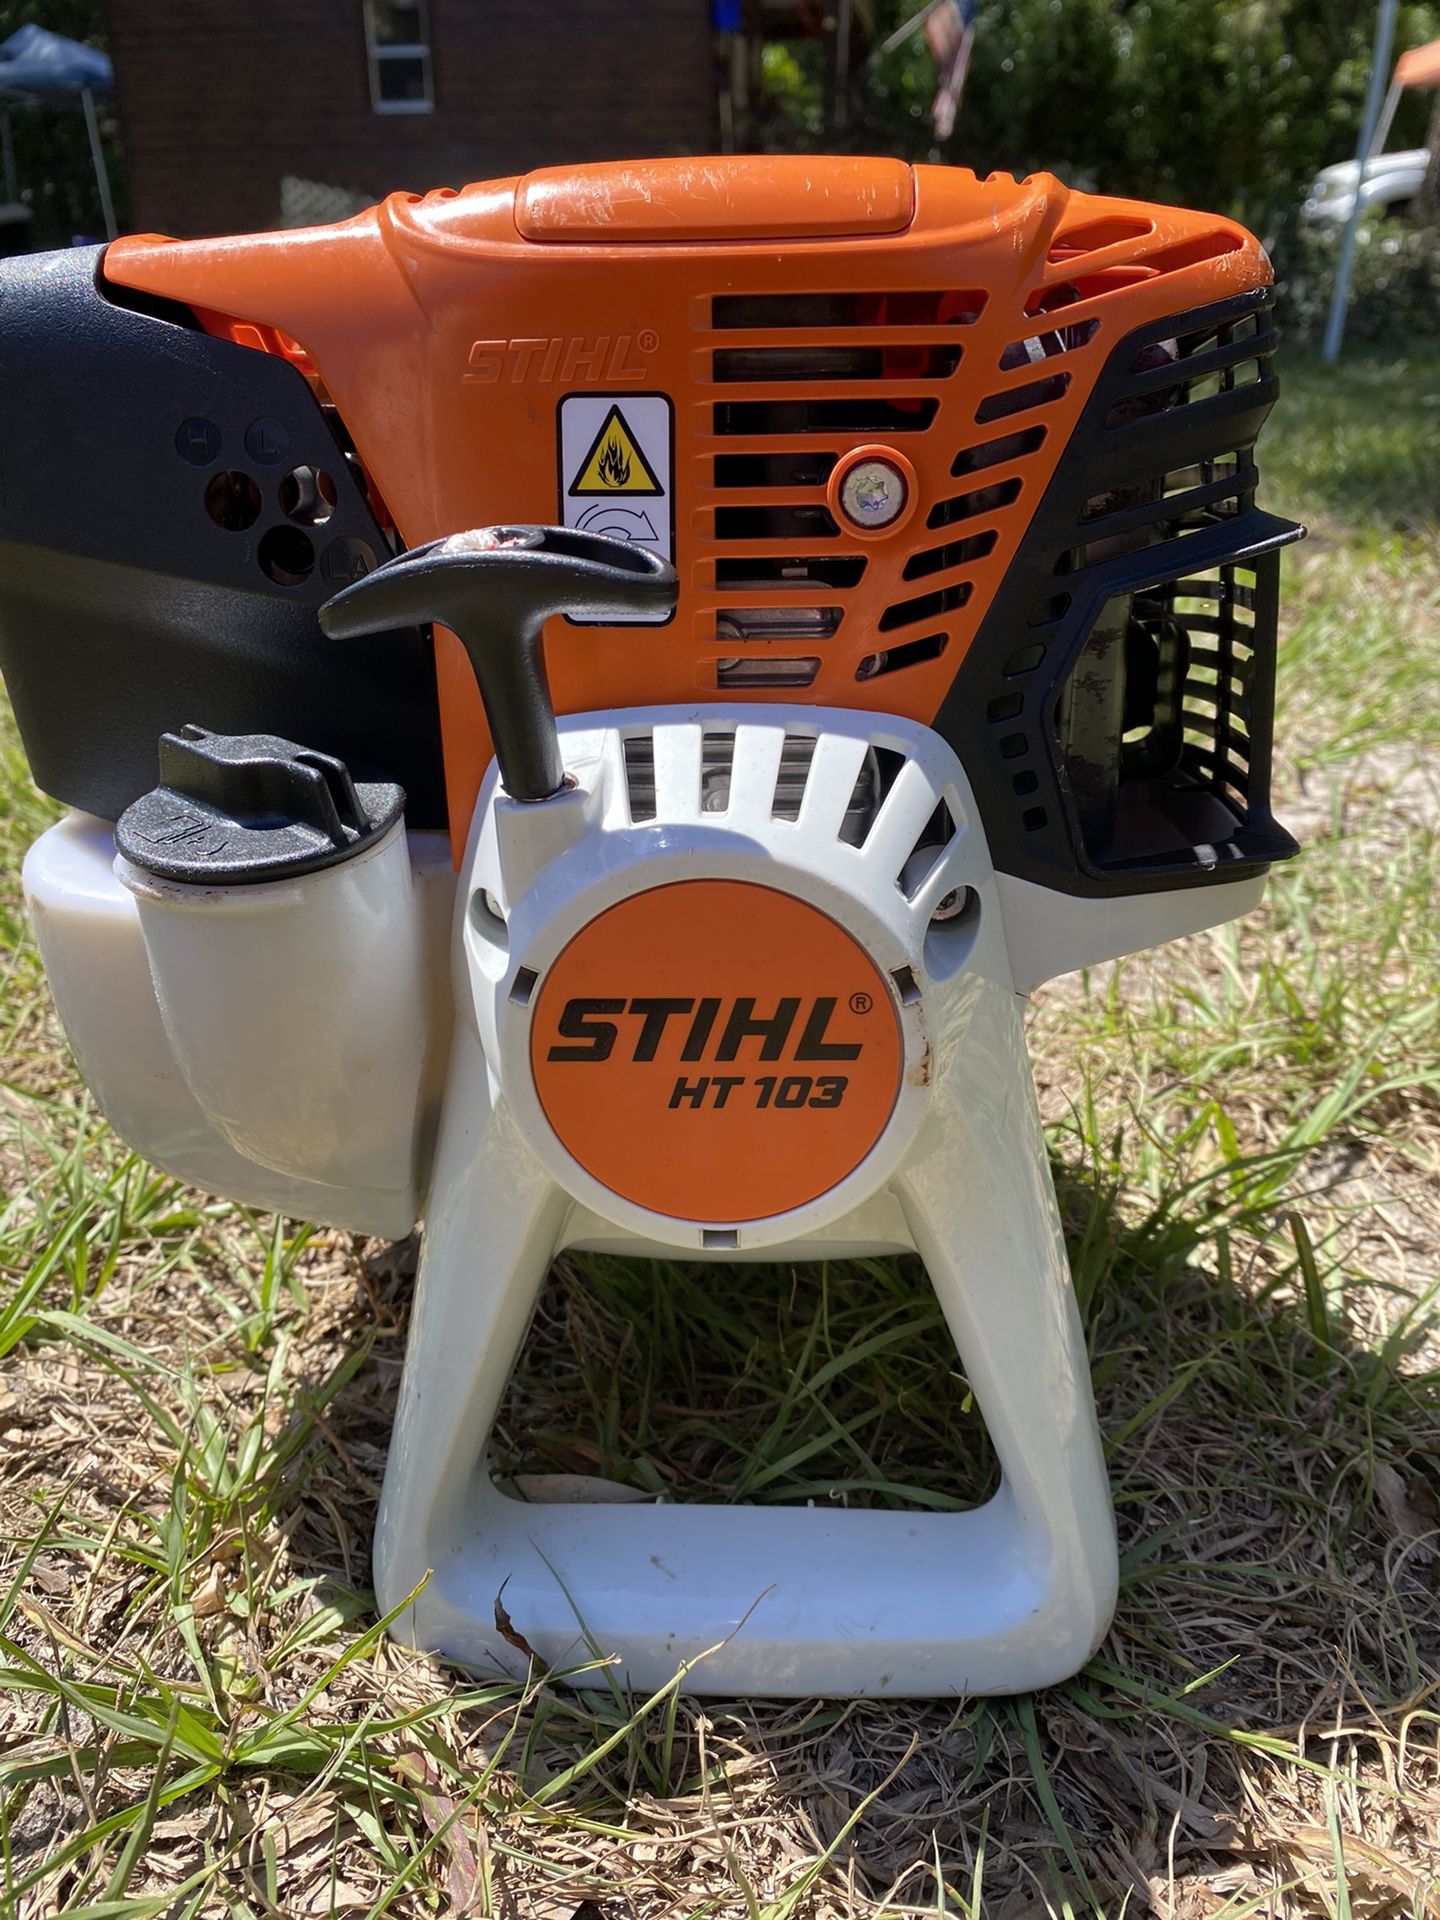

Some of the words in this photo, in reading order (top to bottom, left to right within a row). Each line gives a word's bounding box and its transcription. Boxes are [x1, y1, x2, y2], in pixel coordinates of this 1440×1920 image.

[188, 428, 209, 455] H
[260, 428, 280, 456] L
[668, 1077, 745, 1108] HT
[754, 1076, 849, 1108] 103
